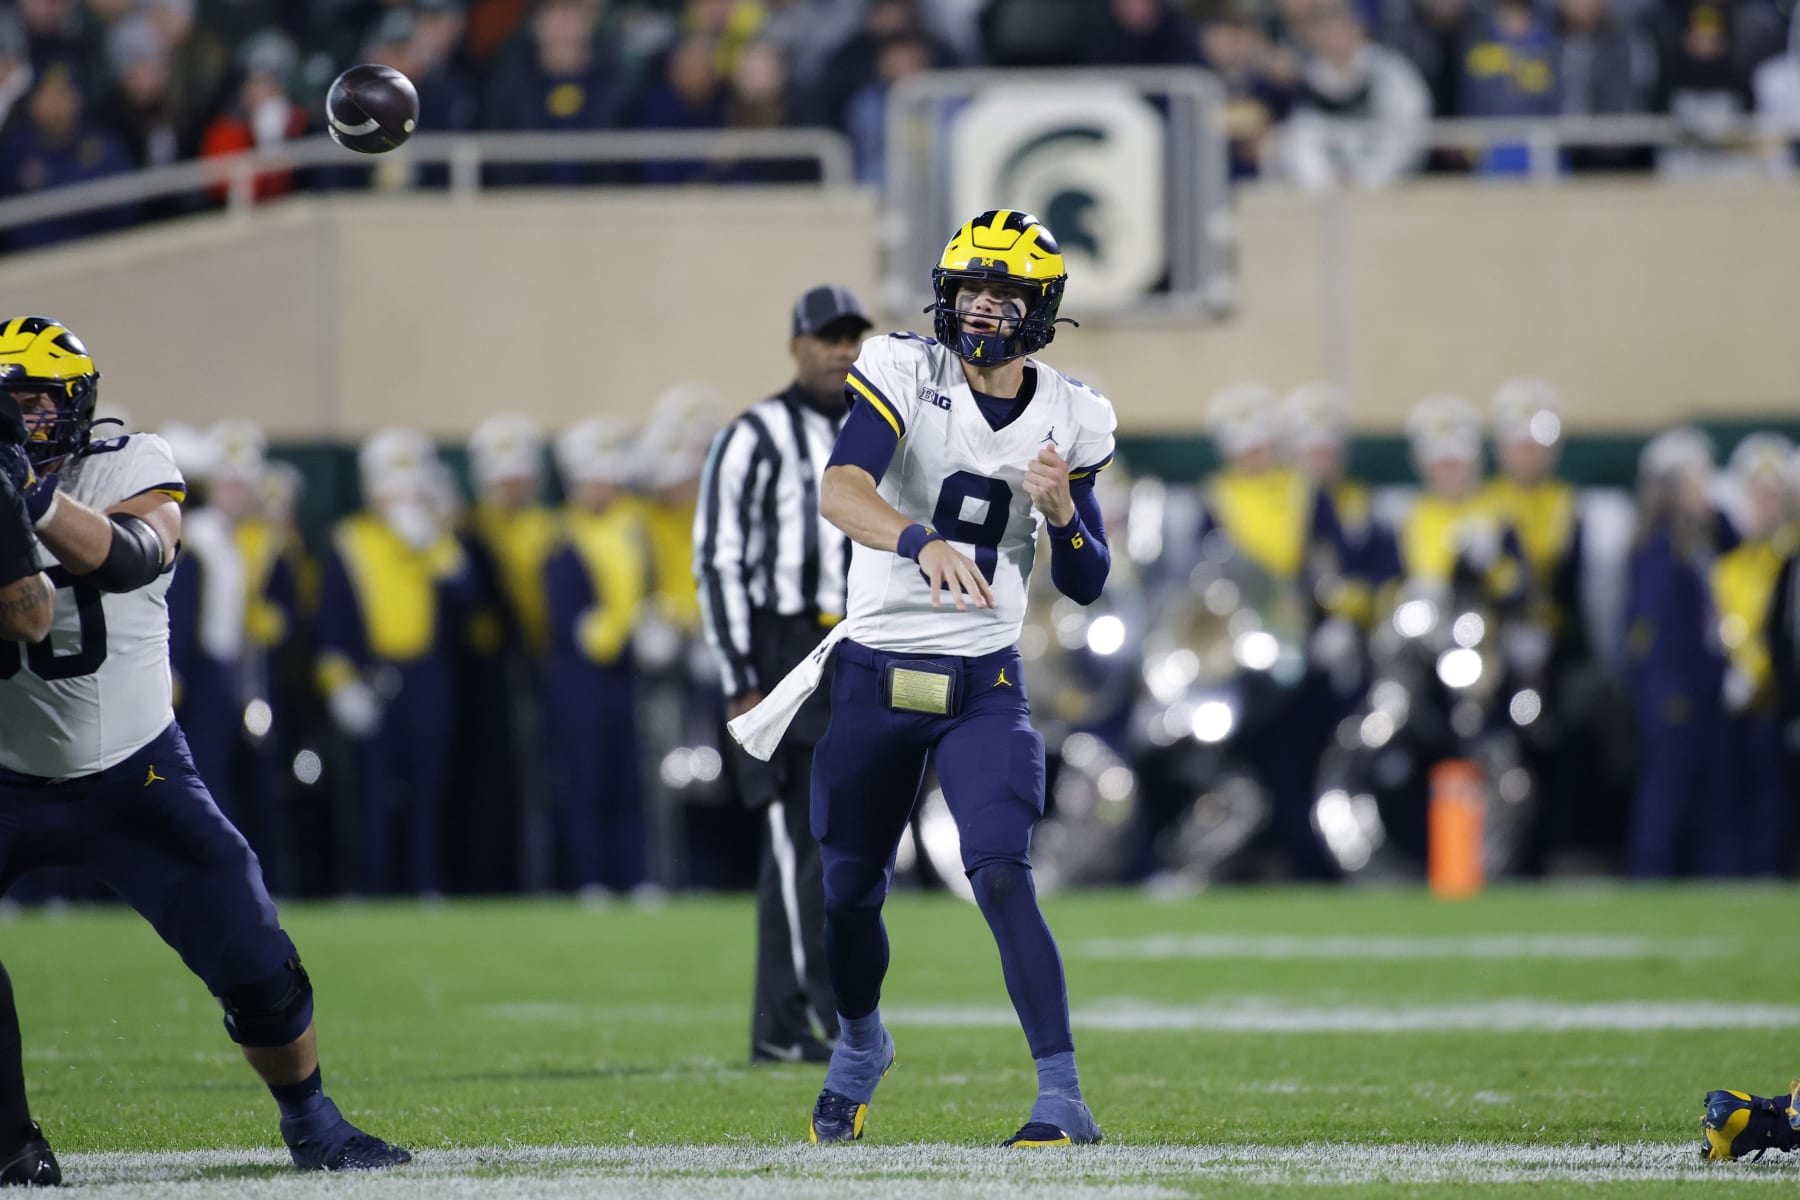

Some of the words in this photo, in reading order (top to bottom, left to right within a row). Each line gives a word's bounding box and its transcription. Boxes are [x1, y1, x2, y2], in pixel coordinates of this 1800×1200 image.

[981, 257, 995, 268] M
[920, 470, 1013, 594] 9
[1071, 531, 1085, 550] 6
